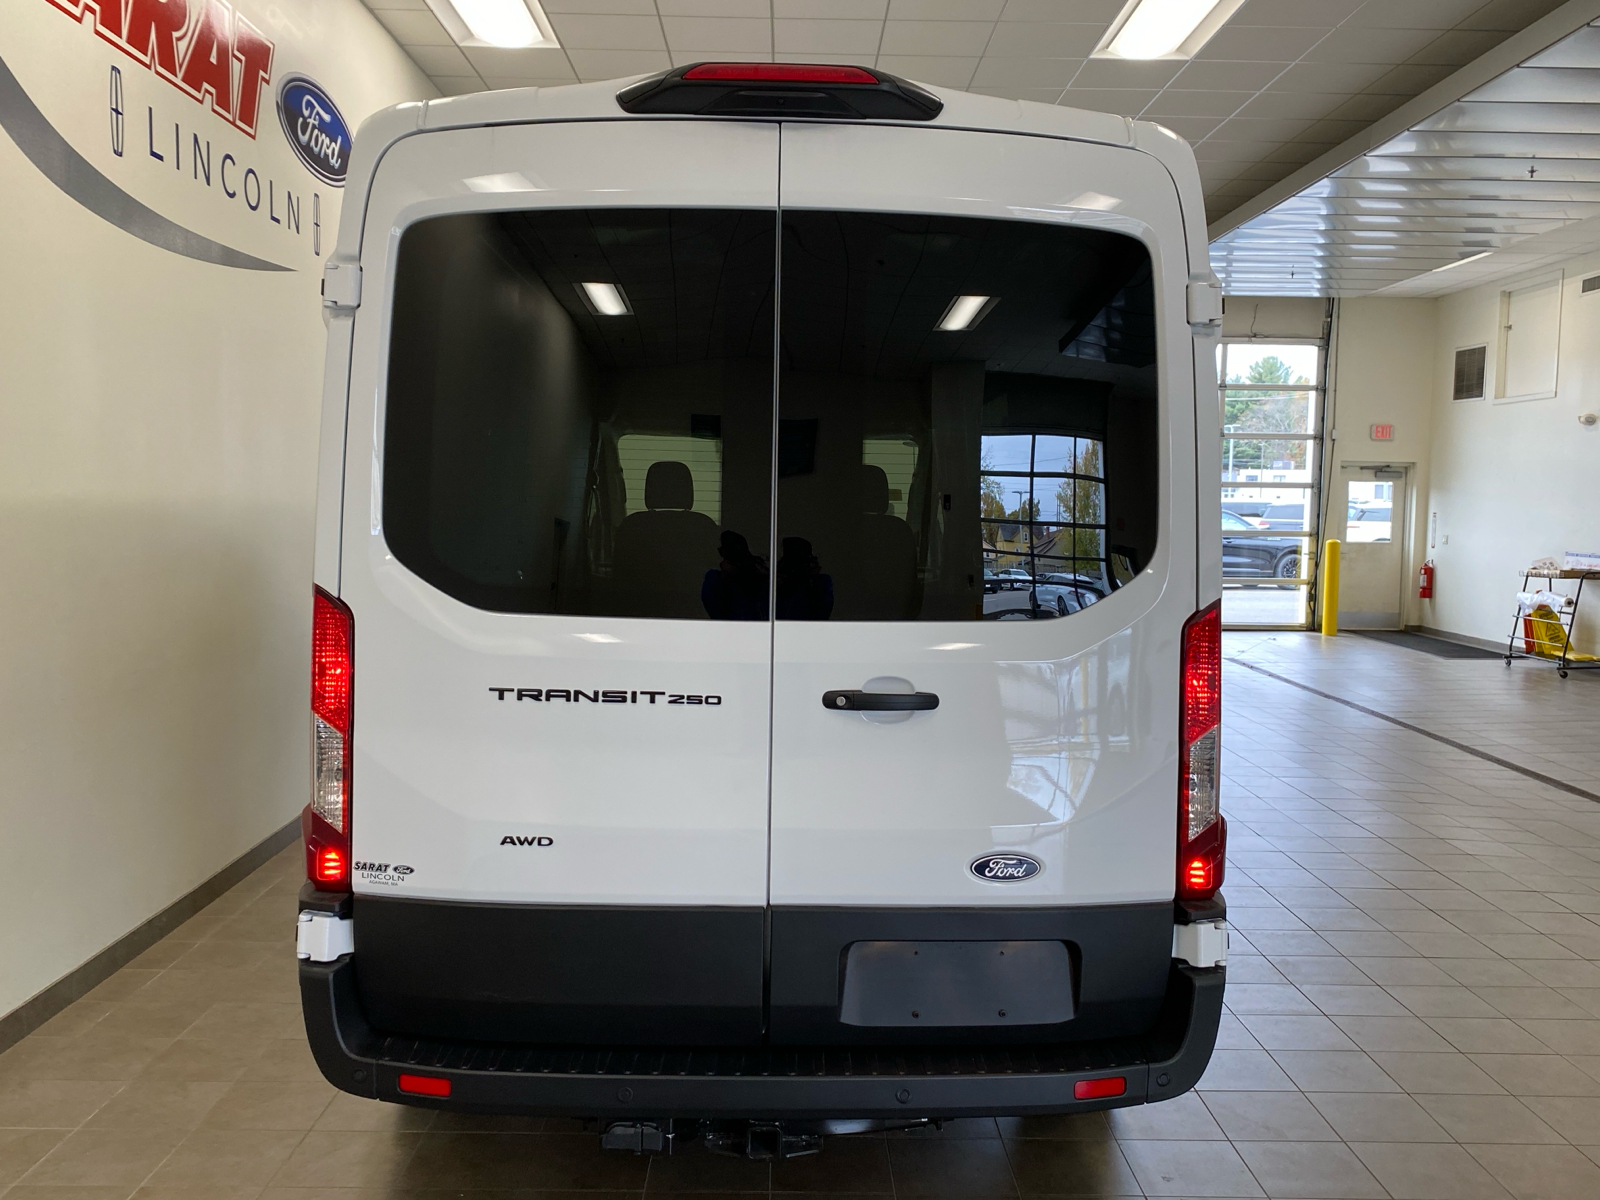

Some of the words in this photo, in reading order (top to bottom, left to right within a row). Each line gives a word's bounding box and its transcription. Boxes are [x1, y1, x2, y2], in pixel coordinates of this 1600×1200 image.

[297, 94, 342, 169] Ford
[147, 105, 300, 235] LINCOLN
[1374, 424, 1392, 438] EXIT
[499, 835, 553, 846] AWD
[353, 861, 390, 873] SARAT
[985, 858, 1026, 877] Ford
[361, 872, 405, 881] LINCOLN
